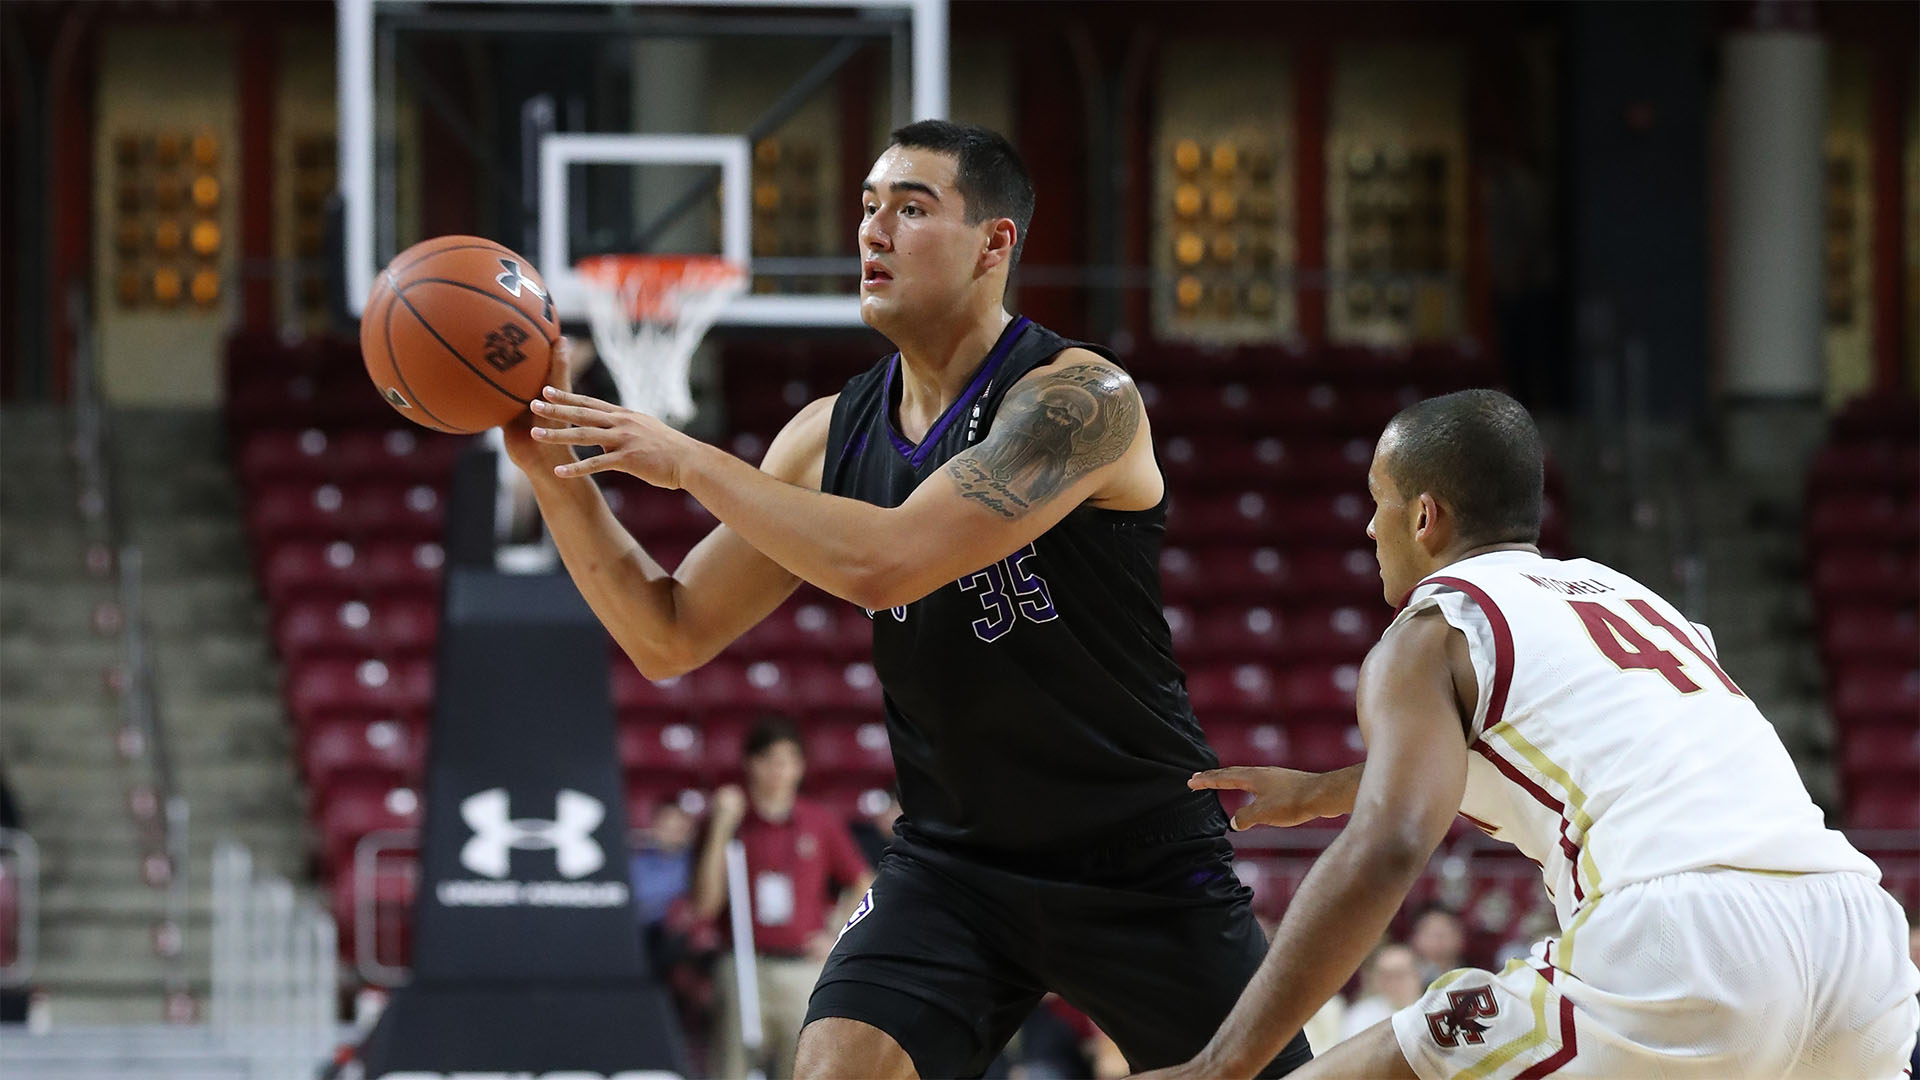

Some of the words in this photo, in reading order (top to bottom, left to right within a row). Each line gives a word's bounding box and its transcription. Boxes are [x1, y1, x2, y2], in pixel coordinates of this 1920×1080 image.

[957, 541, 1059, 643] 35
[1519, 572, 1616, 595] MITCHELL
[1562, 597, 1748, 700] 41
